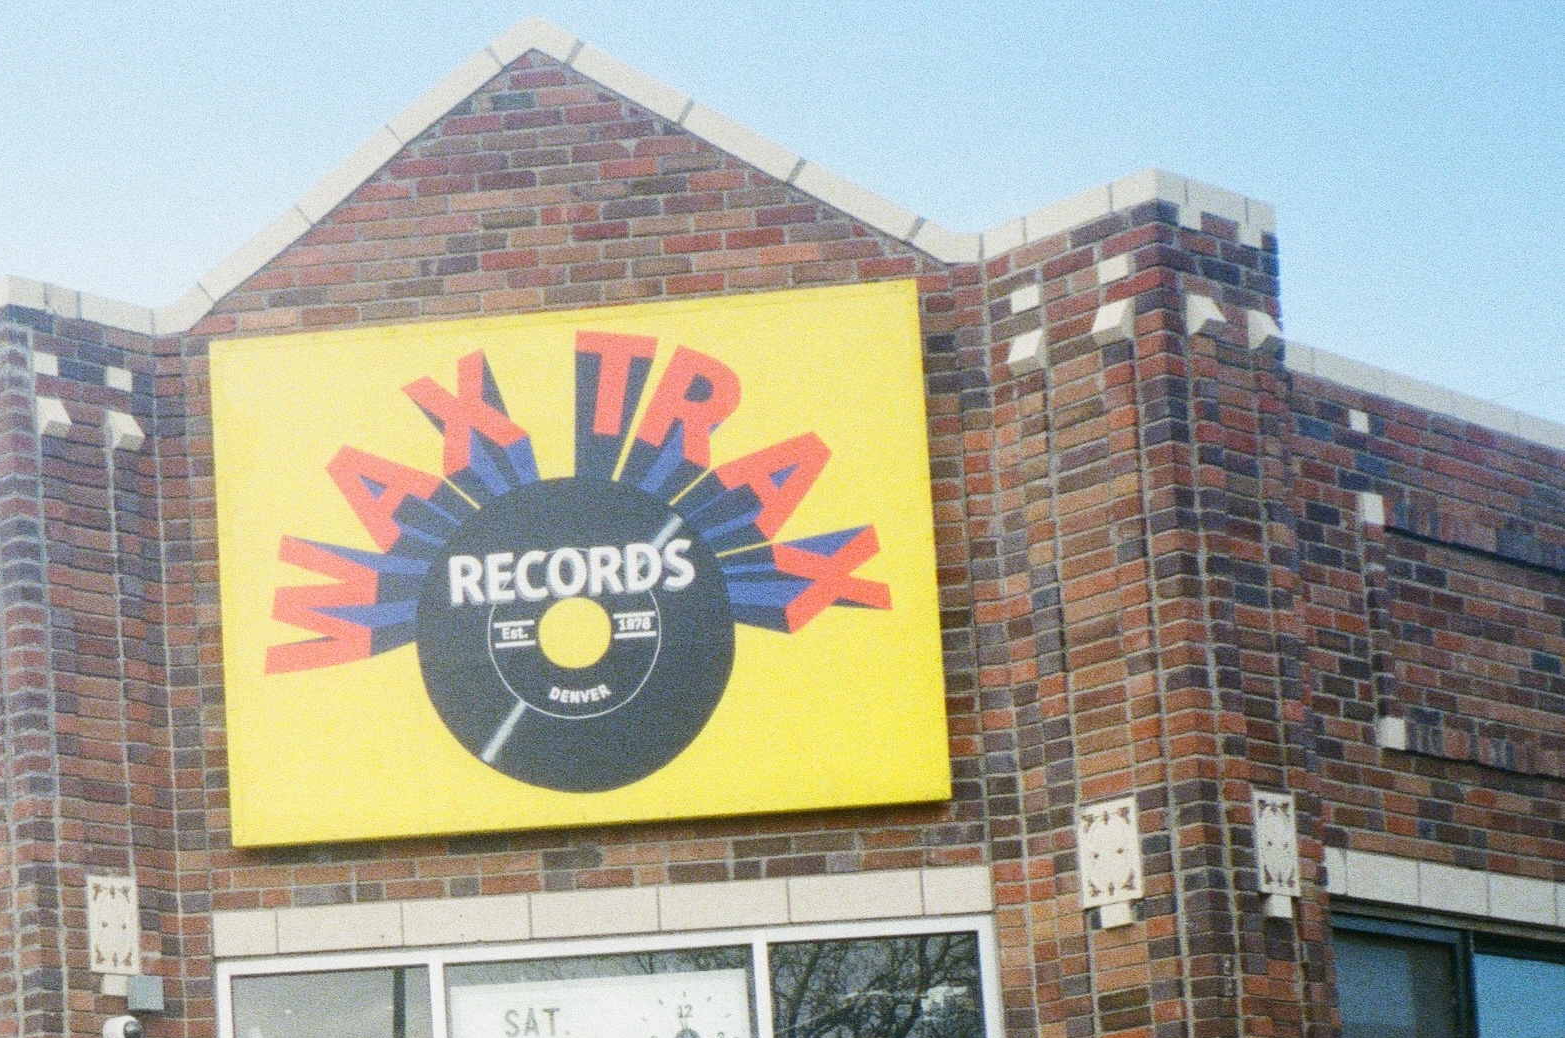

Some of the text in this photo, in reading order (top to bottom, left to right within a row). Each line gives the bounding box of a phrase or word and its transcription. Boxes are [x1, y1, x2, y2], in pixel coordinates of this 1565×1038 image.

[264, 330, 894, 676] WAX TRAX
[449, 539, 696, 606] RECORDS
[501, 625, 529, 641] Est.
[548, 683, 612, 704] DENVER
[677, 1004, 694, 1019] 12
